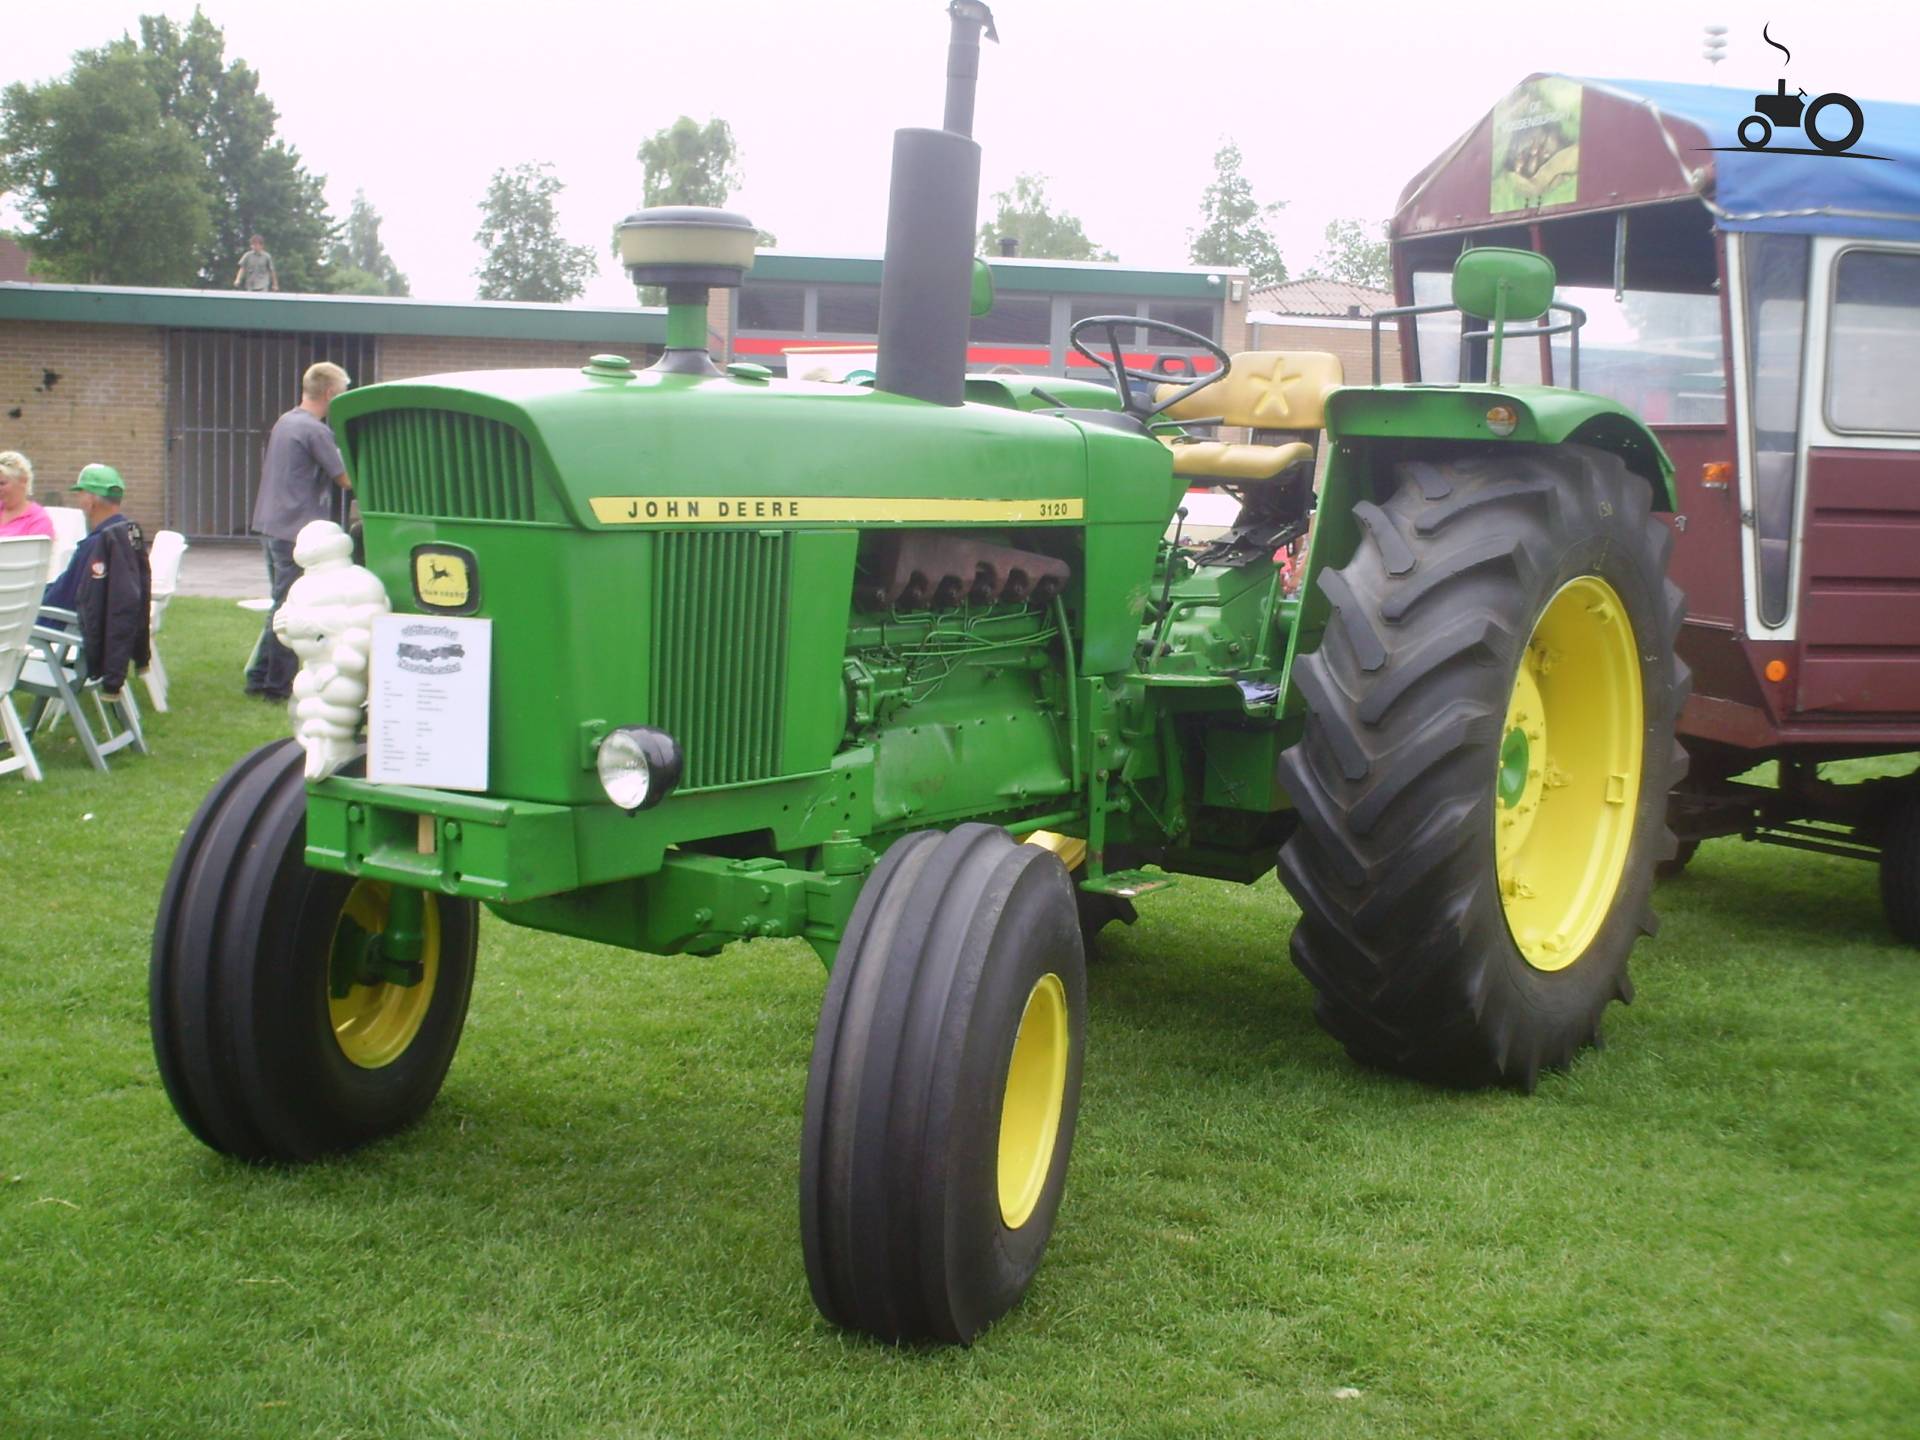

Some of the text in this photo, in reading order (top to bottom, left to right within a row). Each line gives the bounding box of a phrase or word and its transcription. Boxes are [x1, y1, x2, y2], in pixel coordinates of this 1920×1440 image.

[628, 501, 1068, 518] JOHN DEERE 3120
